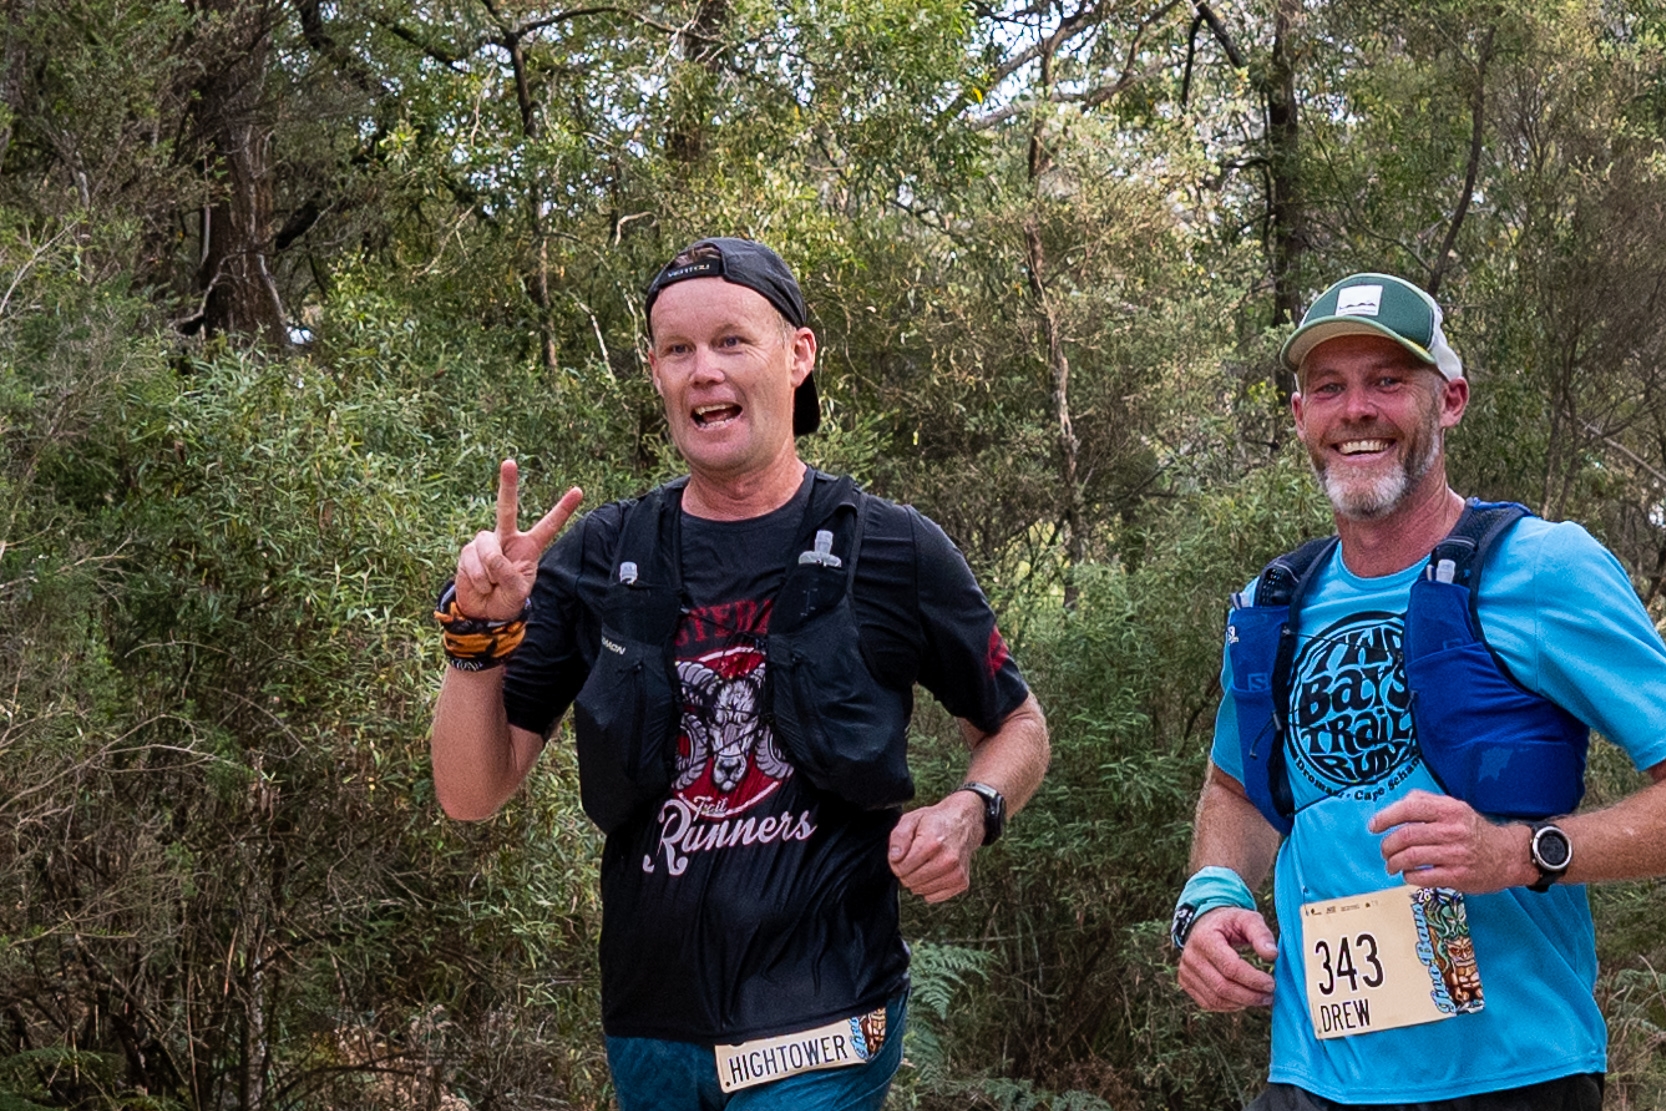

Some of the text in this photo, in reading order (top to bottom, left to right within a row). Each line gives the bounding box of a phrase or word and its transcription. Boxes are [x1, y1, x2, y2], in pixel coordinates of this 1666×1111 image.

[642, 799, 817, 876] Runners
[1315, 933, 1384, 995] 343
[1320, 998, 1371, 1032] DREW
[729, 1034, 848, 1084] HIGHTOWER
